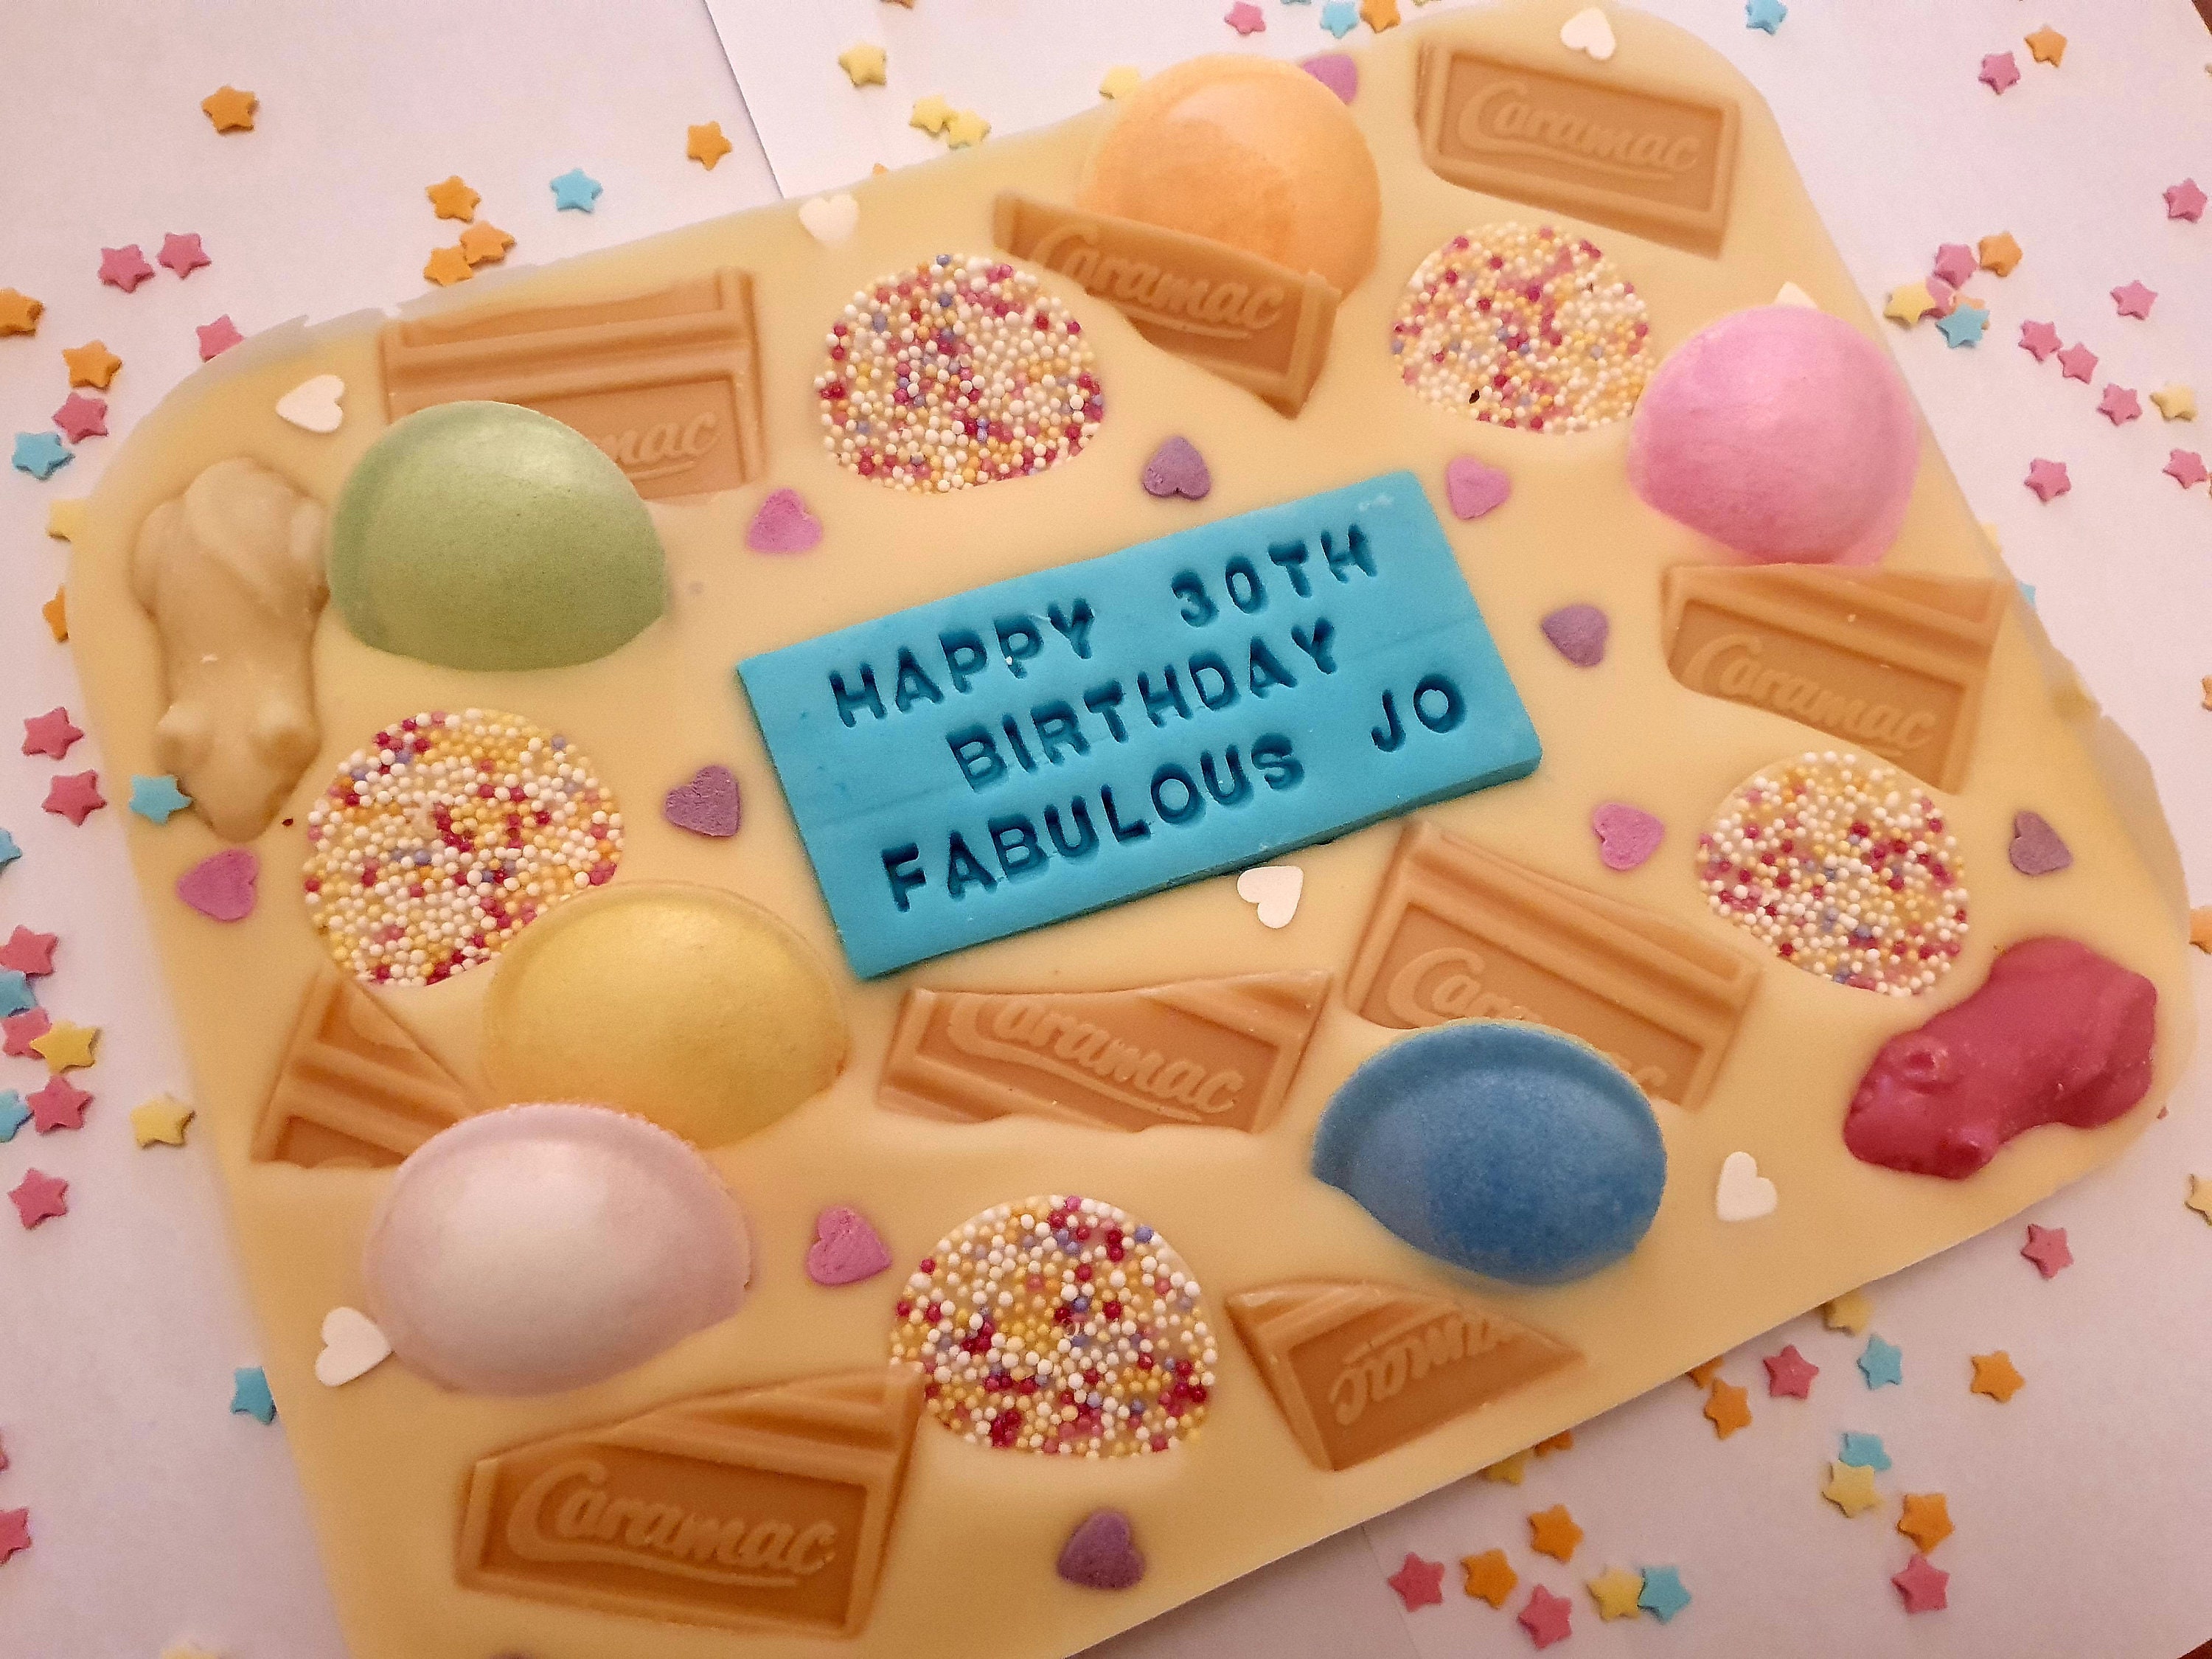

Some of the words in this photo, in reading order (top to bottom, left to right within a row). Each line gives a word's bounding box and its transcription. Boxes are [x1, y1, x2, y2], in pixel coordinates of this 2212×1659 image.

[1457, 79, 1702, 181] Caramac
[1029, 221, 1285, 340] Caramac
[827, 598, 1095, 728] HAPPY
[1172, 523, 1380, 628] 30TH
[946, 618, 1338, 792] BIRTHDAY
[1683, 633, 1937, 757] Caramac
[880, 734, 1306, 911] FABULOUS
[1371, 672, 1467, 752] JO
[507, 1458, 838, 1587] Caramac
